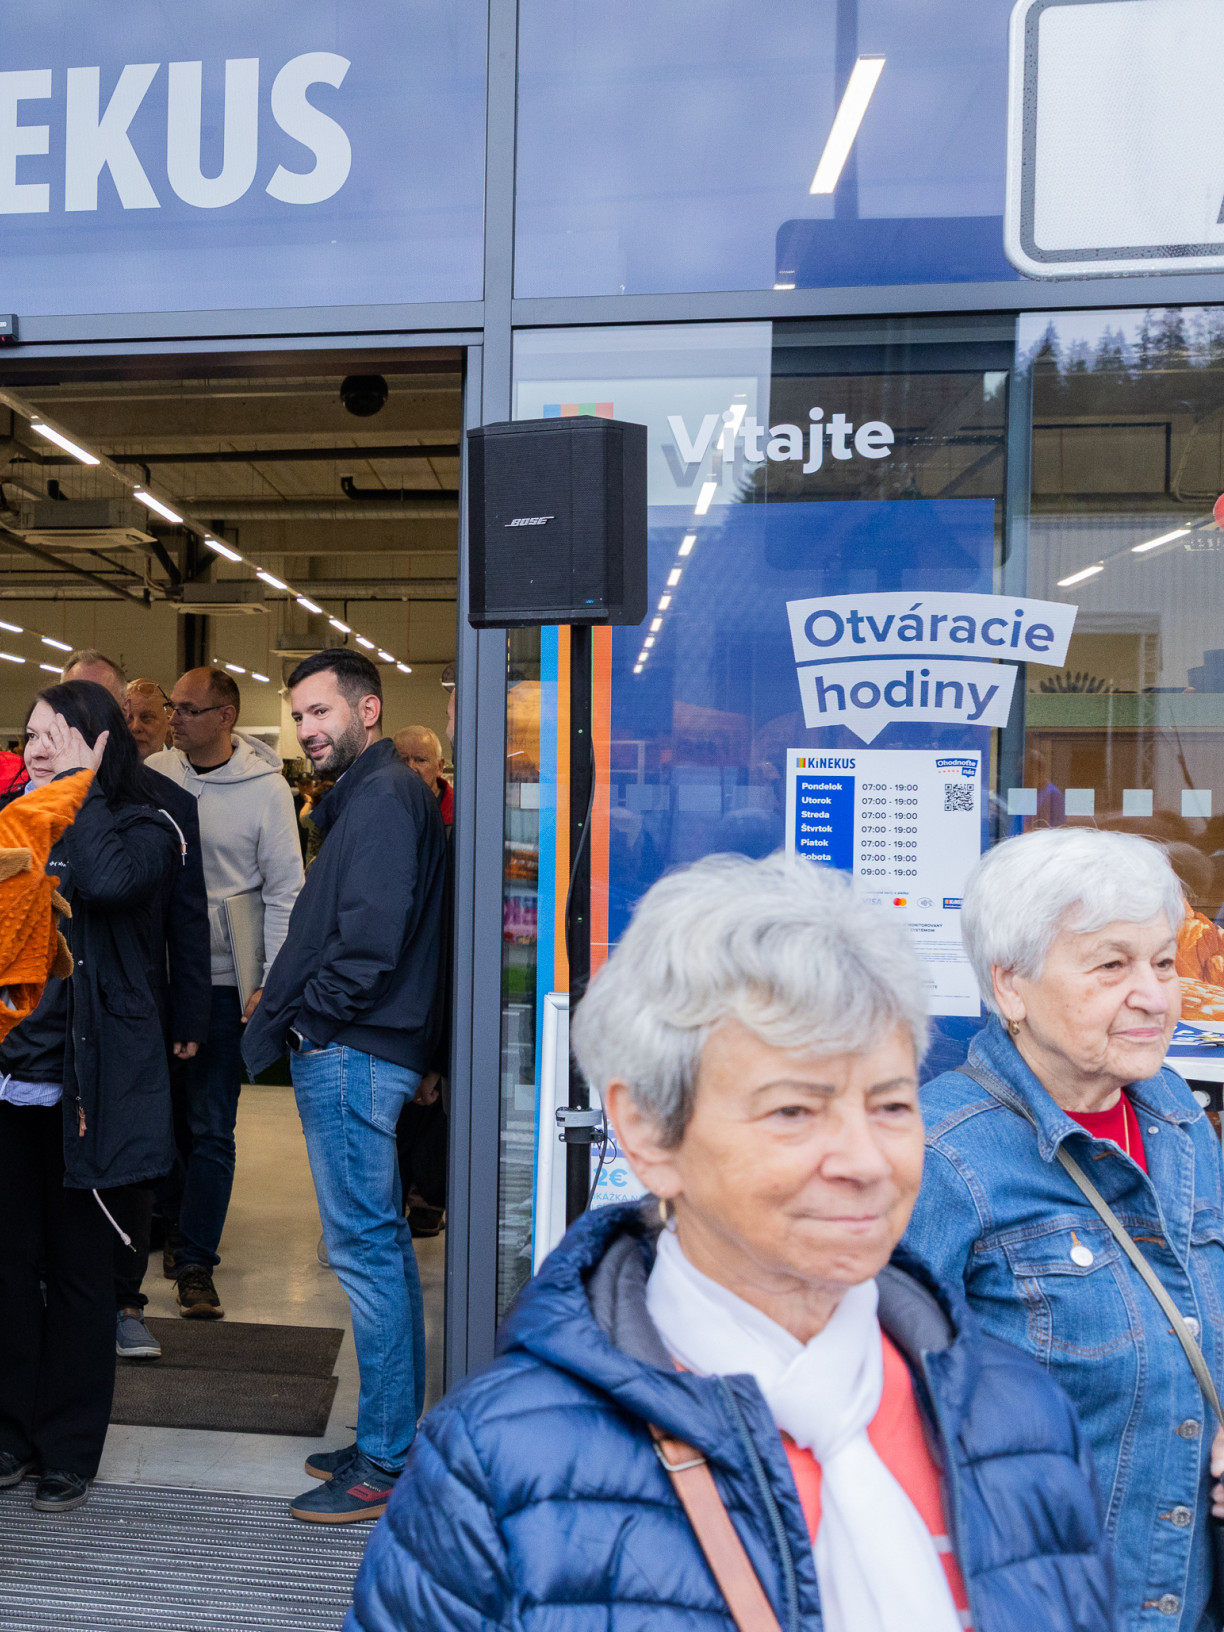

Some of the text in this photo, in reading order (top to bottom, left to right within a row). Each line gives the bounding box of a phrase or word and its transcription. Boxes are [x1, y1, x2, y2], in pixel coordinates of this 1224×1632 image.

[668, 406, 895, 474] Vitajte
[505, 516, 555, 527] BOSE
[804, 602, 1055, 652] Otváracie
[815, 668, 1000, 721] hodiny
[801, 782, 843, 790] Pondelok
[894, 784, 918, 792] 19:00
[801, 796, 832, 804] Utorok
[894, 798, 918, 806] 19:00
[801, 810, 830, 818] Streda
[894, 812, 918, 820] 19:00
[800, 823, 833, 833] Štvrtok
[894, 826, 918, 834] 19:00
[800, 838, 829, 846] Piatok
[894, 840, 918, 848] 19:00
[800, 852, 832, 861] Sobota
[894, 854, 918, 862] 19:00
[860, 868, 886, 876] 09:00
